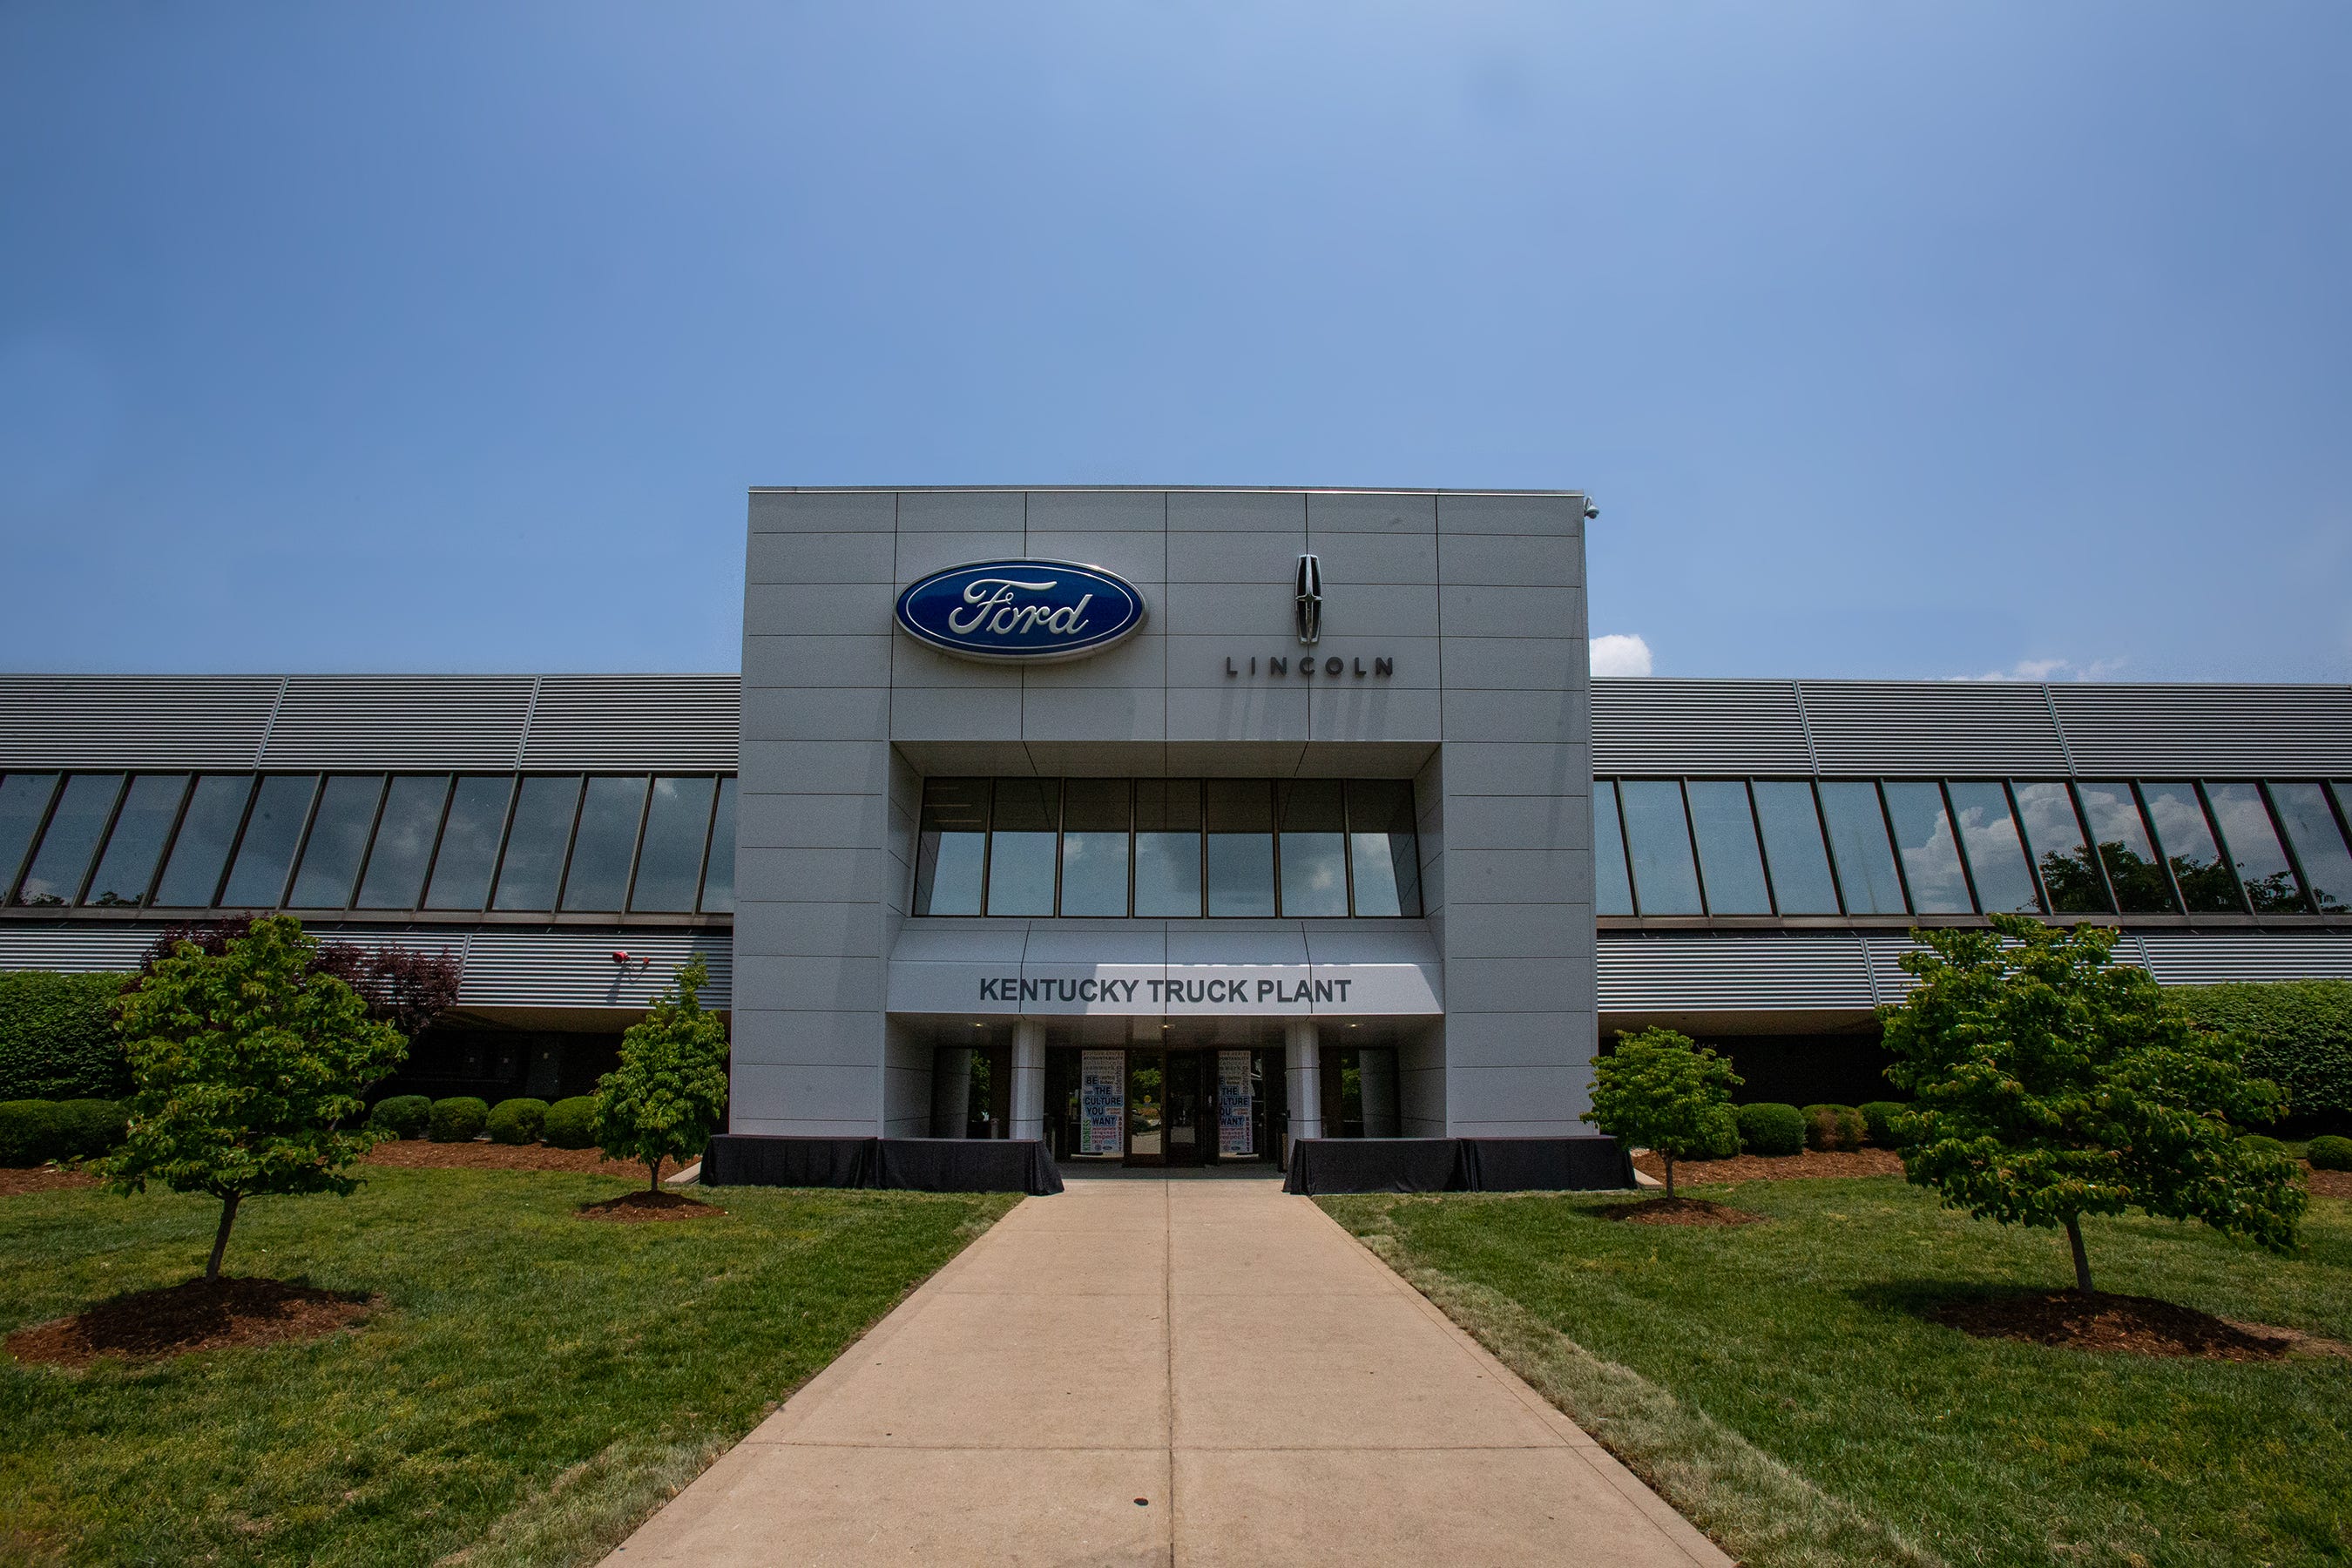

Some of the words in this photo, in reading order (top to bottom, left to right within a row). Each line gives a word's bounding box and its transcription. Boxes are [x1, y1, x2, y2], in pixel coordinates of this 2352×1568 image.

[949, 578, 1092, 636] Ford
[1227, 656, 1394, 676] LINCOLN
[979, 977, 1139, 1003] KENTUCKY
[1147, 978, 1248, 1003] TRUCK
[1257, 979, 1352, 1004] PLANT
[1086, 1076, 1098, 1085] BE
[1095, 1086, 1111, 1095] THE
[1220, 1117, 1243, 1125] WANT
[1083, 1119, 1092, 1151] KINDNESS
